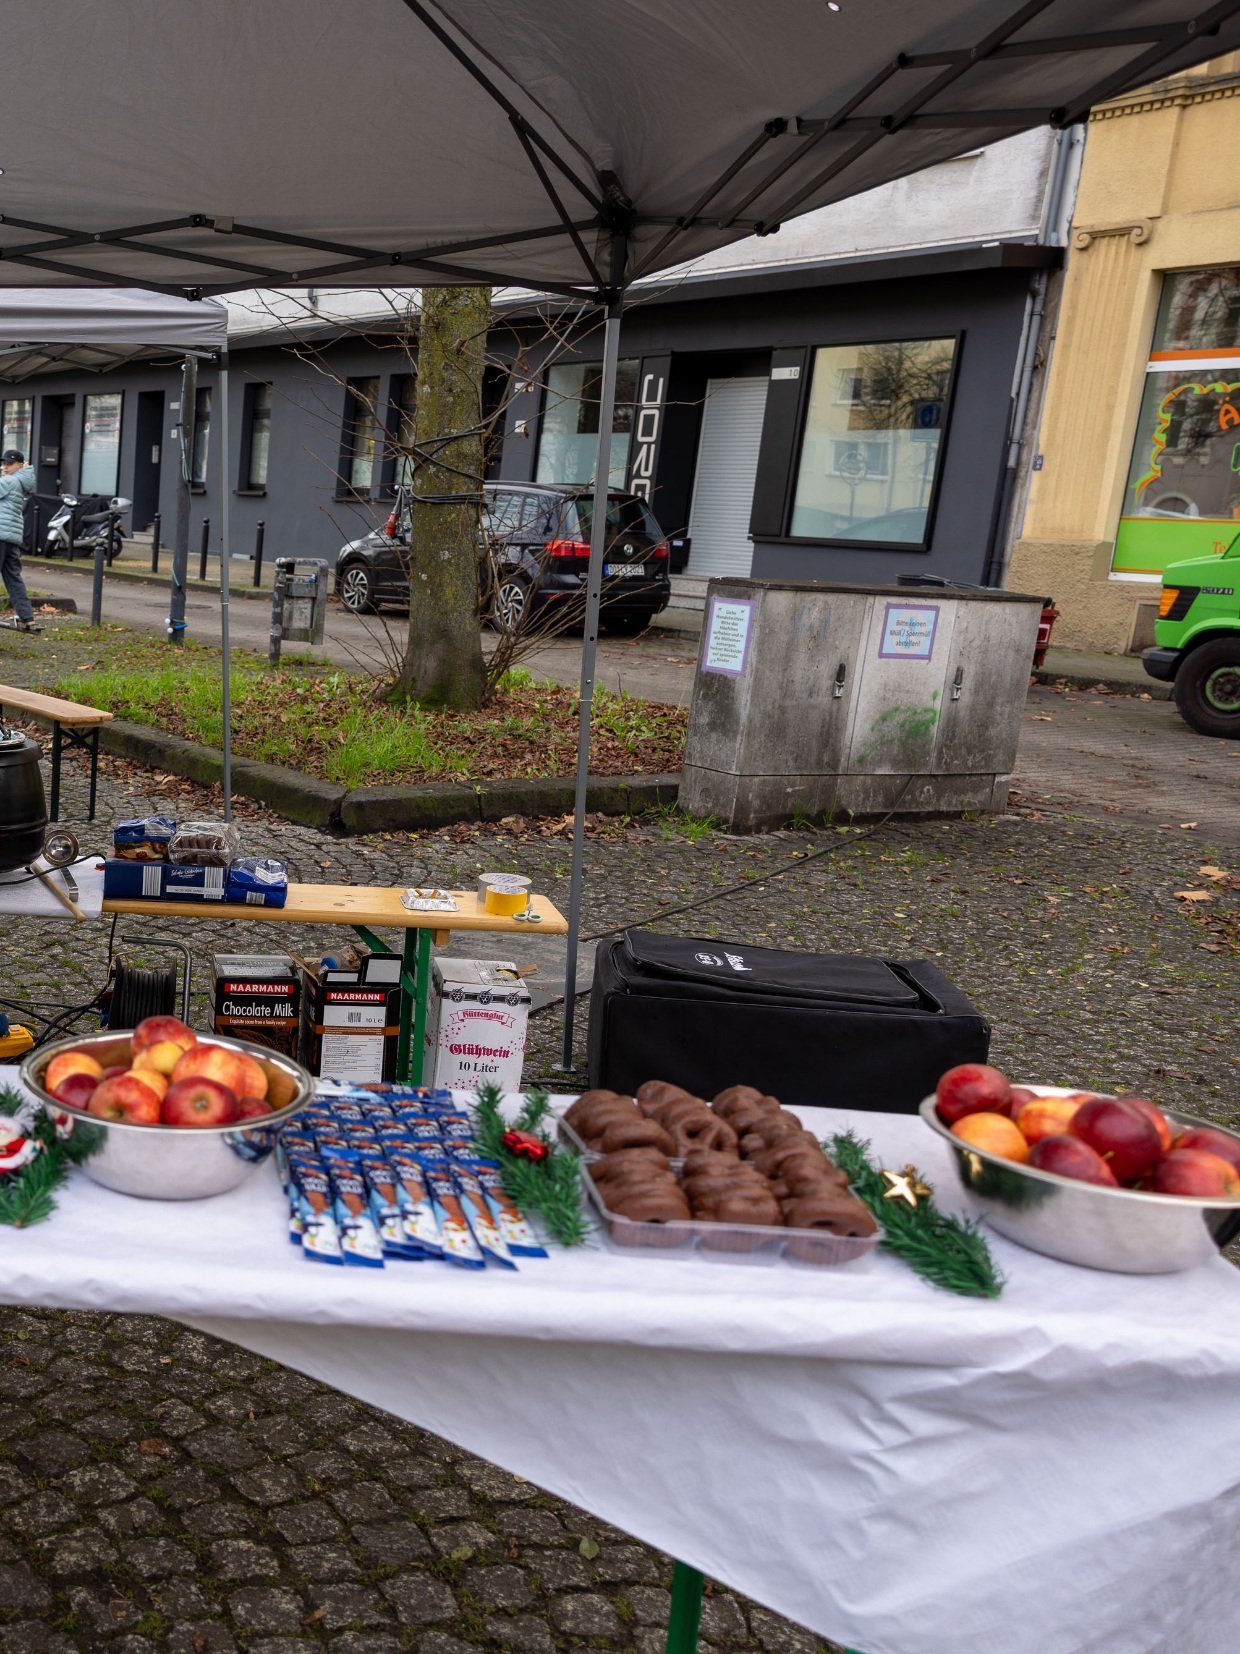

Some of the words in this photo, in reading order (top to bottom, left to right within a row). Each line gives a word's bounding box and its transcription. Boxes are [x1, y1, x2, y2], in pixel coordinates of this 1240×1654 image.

[896, 619, 908, 627] Bitte
[230, 983, 289, 993] NAARMANN
[331, 992, 380, 1001] NAARMANN
[222, 1001, 271, 1017] Chocolate
[273, 1002, 293, 1017] Milk
[449, 1043, 511, 1059] Glühwein
[459, 1061, 471, 1071] 10
[473, 1062, 500, 1073] Liter
